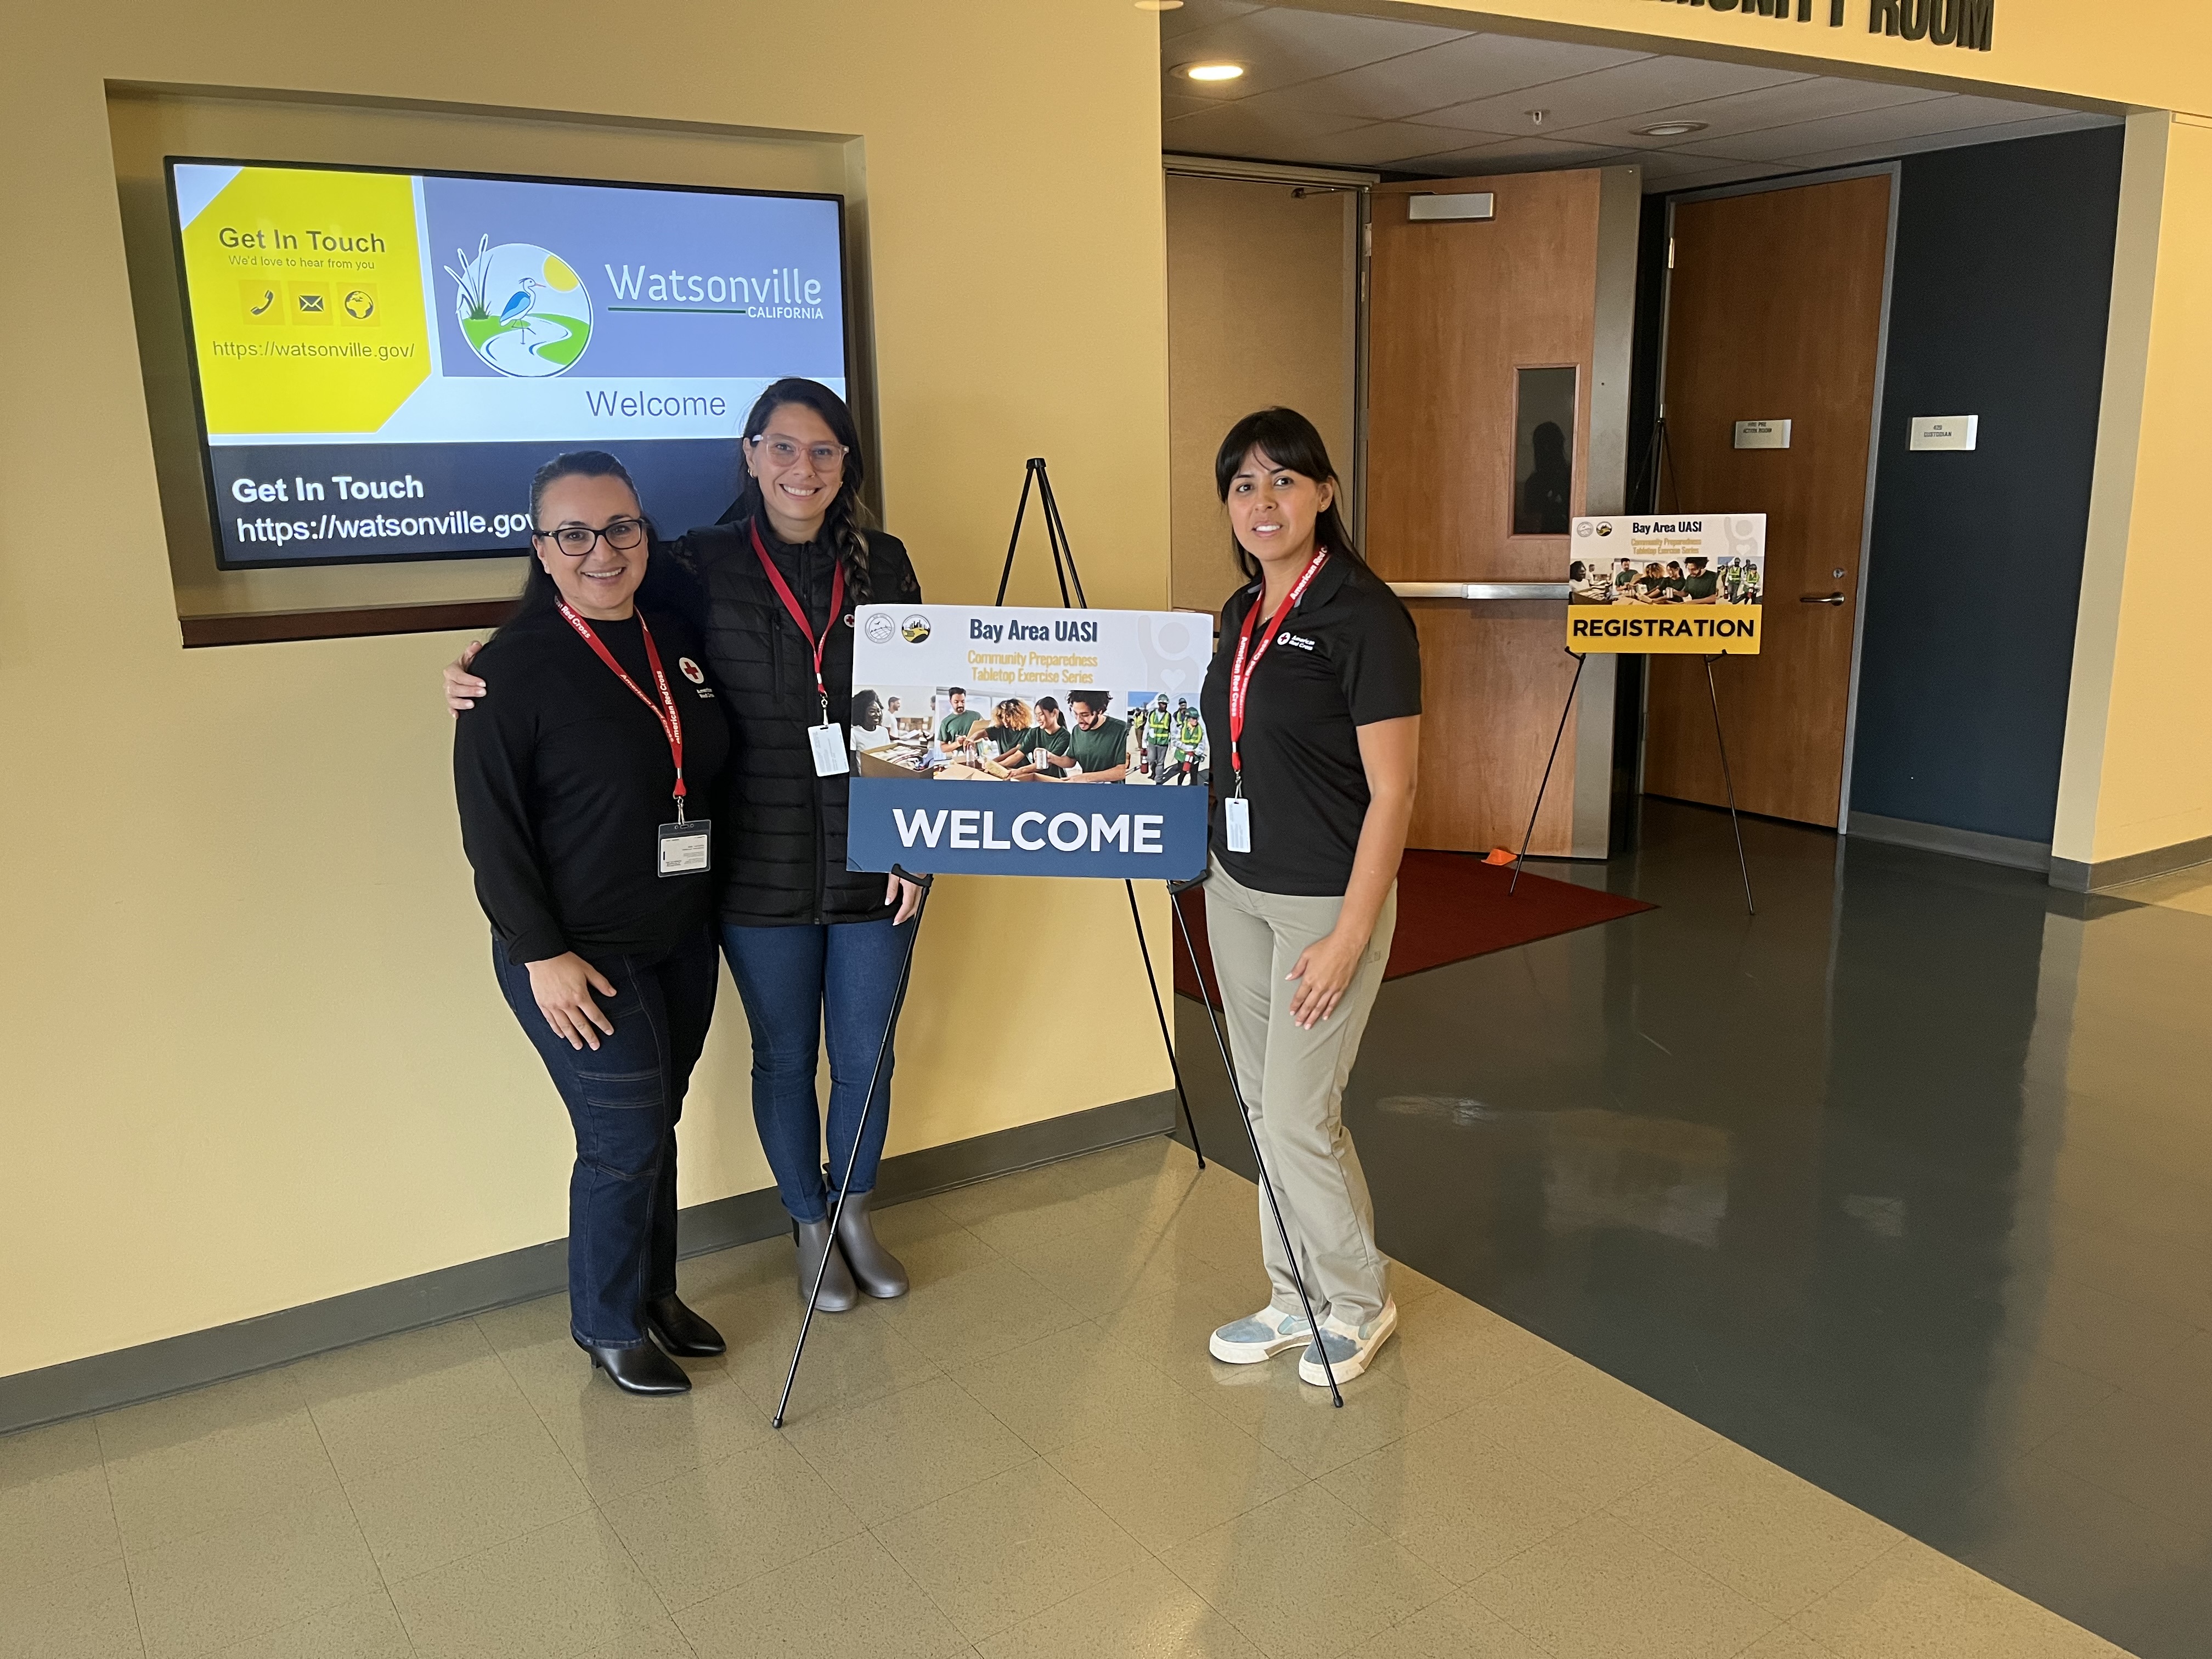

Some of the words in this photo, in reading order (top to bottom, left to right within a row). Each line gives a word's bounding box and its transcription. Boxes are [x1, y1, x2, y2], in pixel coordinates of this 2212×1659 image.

[219, 228, 266, 249] Get
[274, 229, 297, 250] In
[306, 230, 385, 253] Touch
[229, 255, 257, 266] We'd
[261, 256, 283, 267] love
[286, 258, 296, 267] to
[300, 258, 324, 268] hear
[328, 259, 353, 269] from
[356, 261, 375, 270] you
[605, 264, 822, 306] Watsonville
[747, 305, 824, 320] CALIFORNIA
[213, 341, 415, 361] https://watsonville.gov/
[586, 391, 726, 417] Welcome
[232, 478, 288, 503] Get
[295, 477, 325, 501] In
[332, 474, 424, 500] Touch
[1633, 522, 1651, 535] Bay
[1653, 522, 1675, 533] Area
[1679, 521, 1702, 532] UASI
[1290, 565, 1317, 600] American
[1313, 551, 1325, 566] Red
[561, 606, 575, 620] Red
[572, 618, 591, 639] Cross
[970, 619, 1003, 644] Bay
[1008, 619, 1049, 641] Area
[1055, 620, 1097, 642] UASI
[1573, 619, 1754, 637] REGISTRATION
[968, 650, 1026, 667] Community
[1029, 651, 1098, 668] Preparedness
[1234, 636, 1248, 674] American
[656, 671, 667, 691] Cross
[972, 667, 1015, 684] Tabletop
[1018, 668, 1059, 682] Exercise
[1062, 669, 1093, 684] Series
[1233, 675, 1241, 691] Red
[620, 675, 651, 705] American
[662, 691, 673, 705] Red
[669, 706, 680, 744] American
[893, 808, 1164, 853] WELCOME
